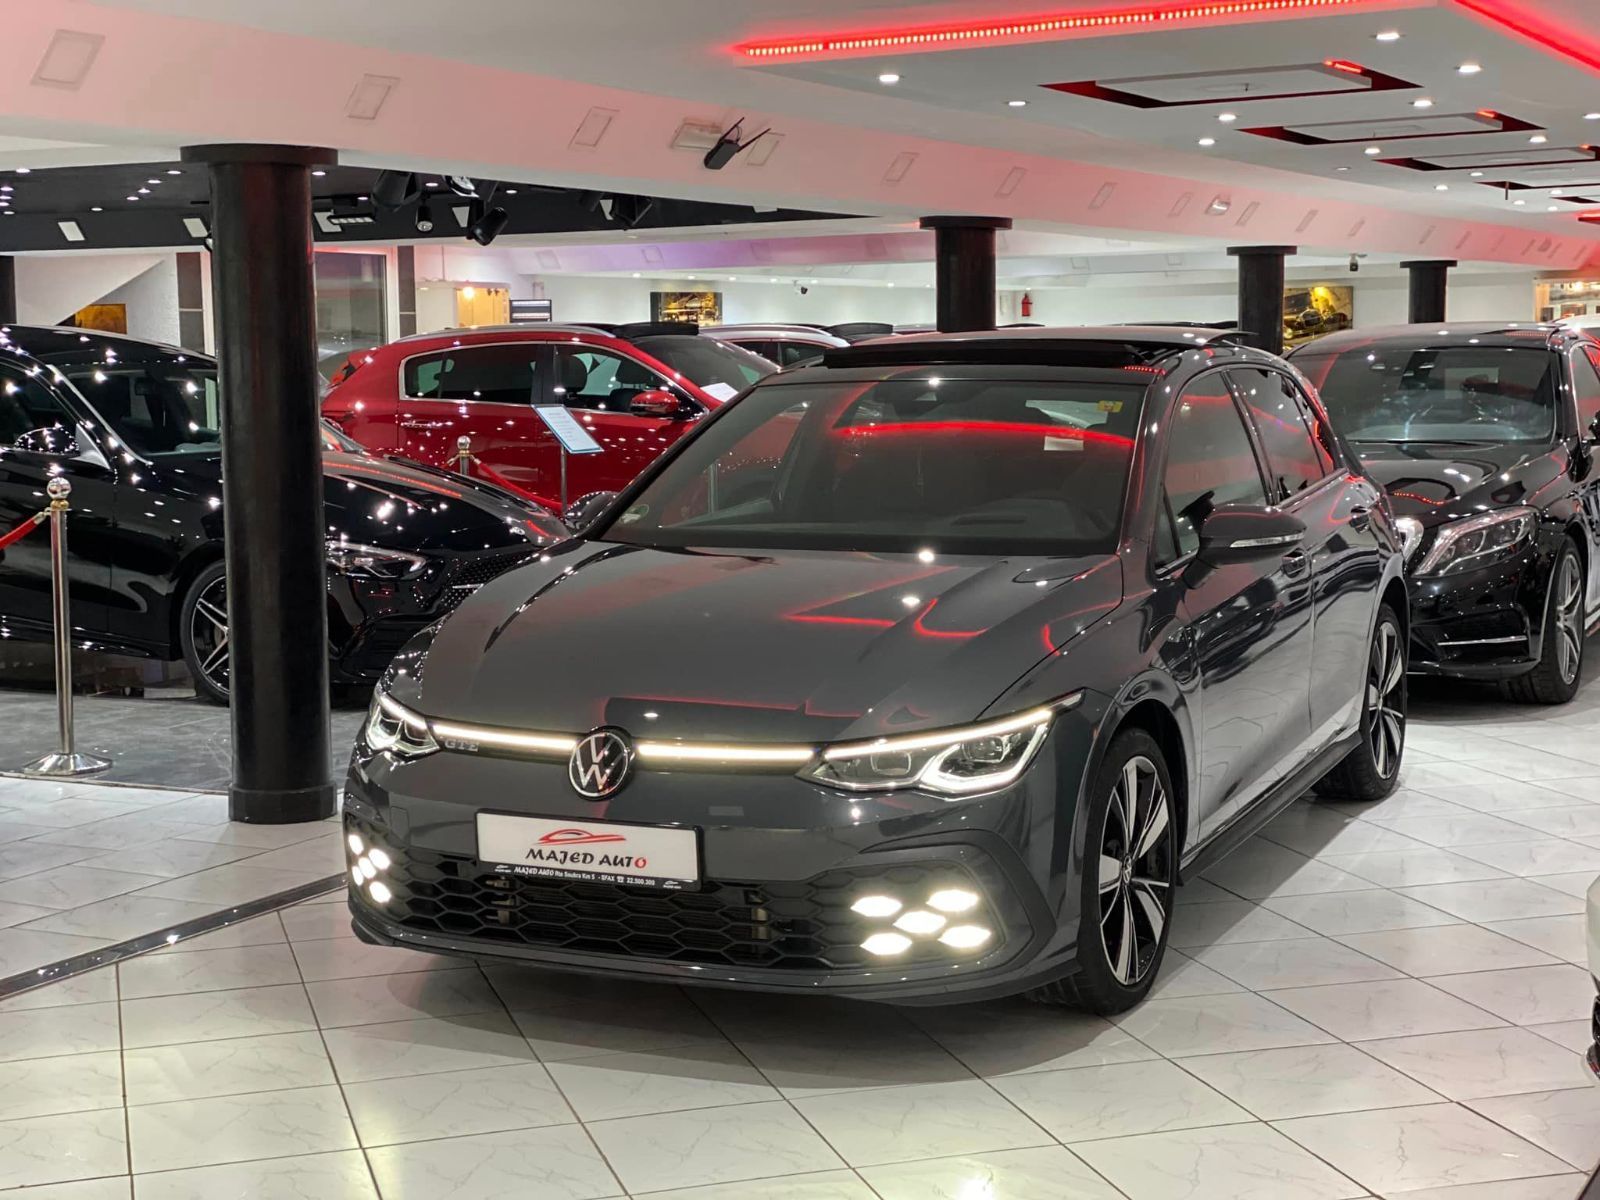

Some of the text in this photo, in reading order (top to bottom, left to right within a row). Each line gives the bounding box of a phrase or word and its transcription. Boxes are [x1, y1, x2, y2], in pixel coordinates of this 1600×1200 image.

[444, 738, 480, 752] GTE
[525, 848, 647, 869] MAJED AUTO
[513, 866, 538, 875] MAJED
[538, 868, 555, 876] AUTO
